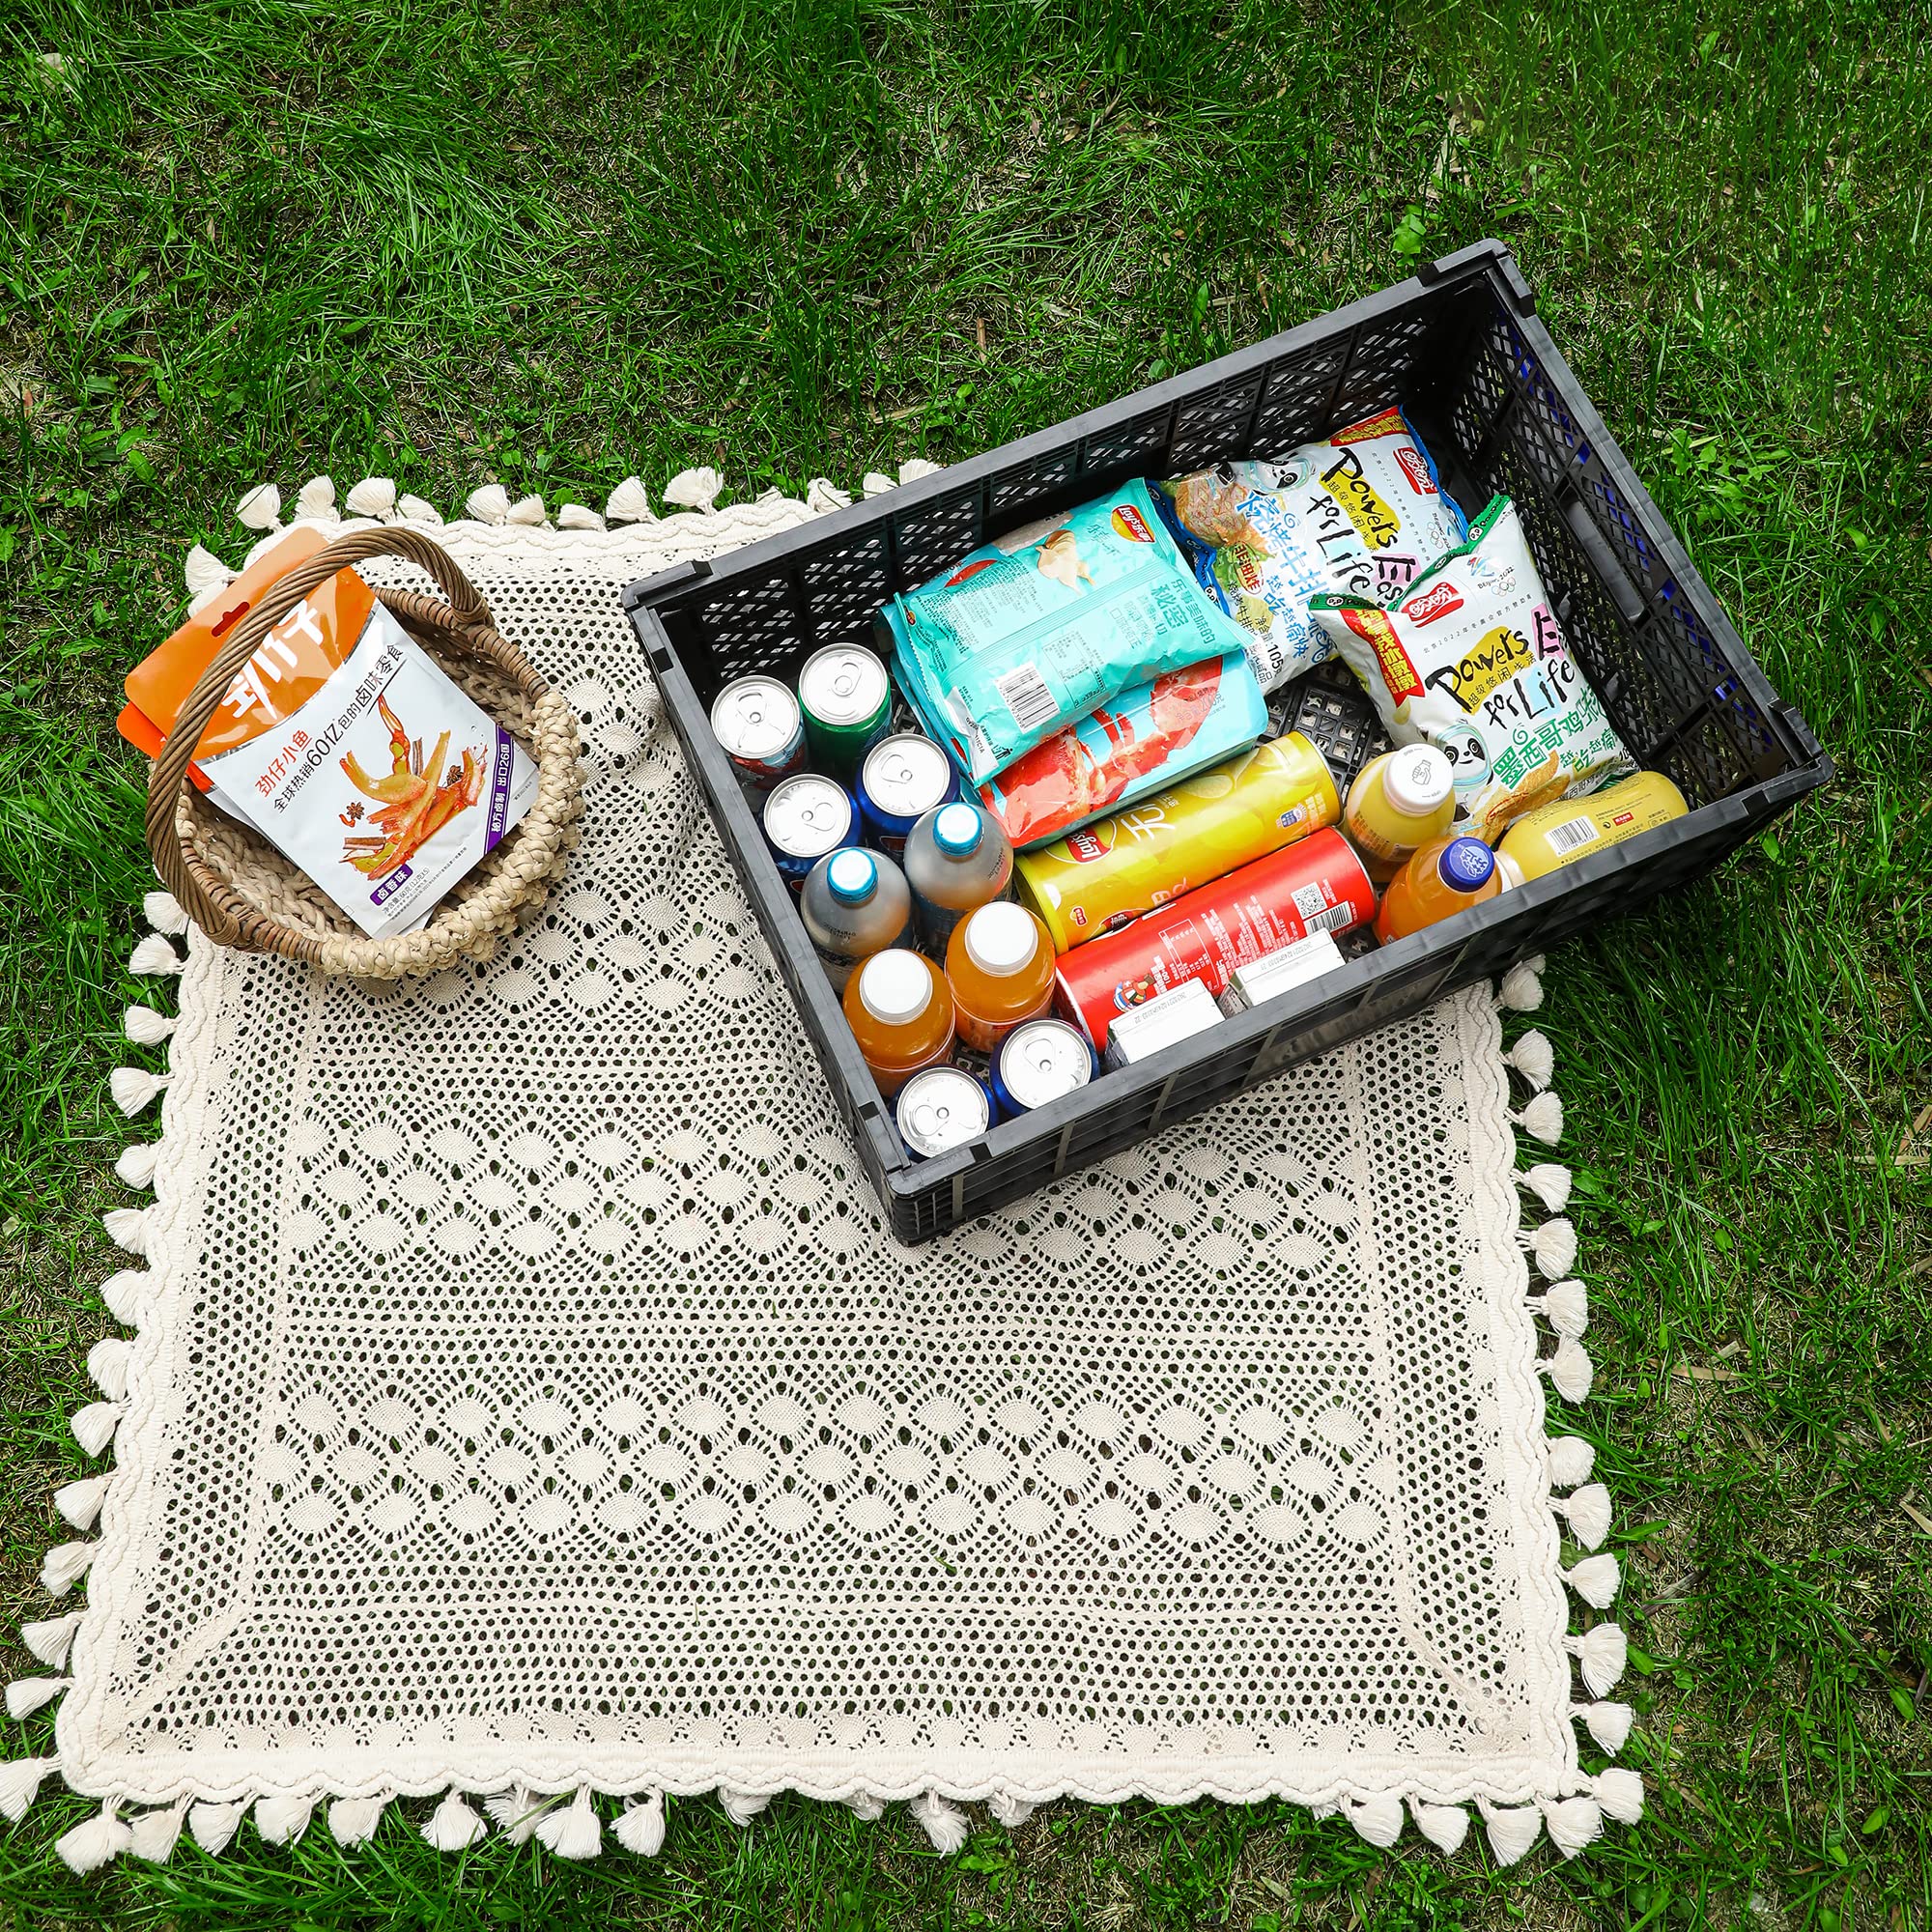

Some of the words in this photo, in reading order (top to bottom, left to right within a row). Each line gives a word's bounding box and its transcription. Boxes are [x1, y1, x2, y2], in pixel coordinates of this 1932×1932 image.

[1307, 496, 1340, 529] for
[1321, 447, 1399, 548] Powers
[1327, 481, 1378, 552] 超级悠闲生活
[1235, 546, 1260, 591] 非油炸
[1317, 529, 1374, 593] Life
[1372, 556, 1415, 608] Eas
[1151, 584, 1189, 629] 秘密
[1171, 579, 1215, 644] 乐事美味的
[1263, 576, 1309, 659] 越吃越痛快
[1408, 583, 1452, 617] 盼盼
[1425, 630, 1528, 713] Powers
[1468, 654, 1536, 707] 超级悠闲生活
[1483, 695, 1519, 729] for
[1514, 659, 1575, 719] Life
[255, 728, 314, 797] 劲仔小鱼
[496, 742, 512, 788] 出口26国
[1559, 727, 1619, 771] 越吃越痛
[490, 790, 506, 834] 秘方卤制
[1072, 829, 1101, 863] Lay's
[376, 868, 410, 902] 卤香味
